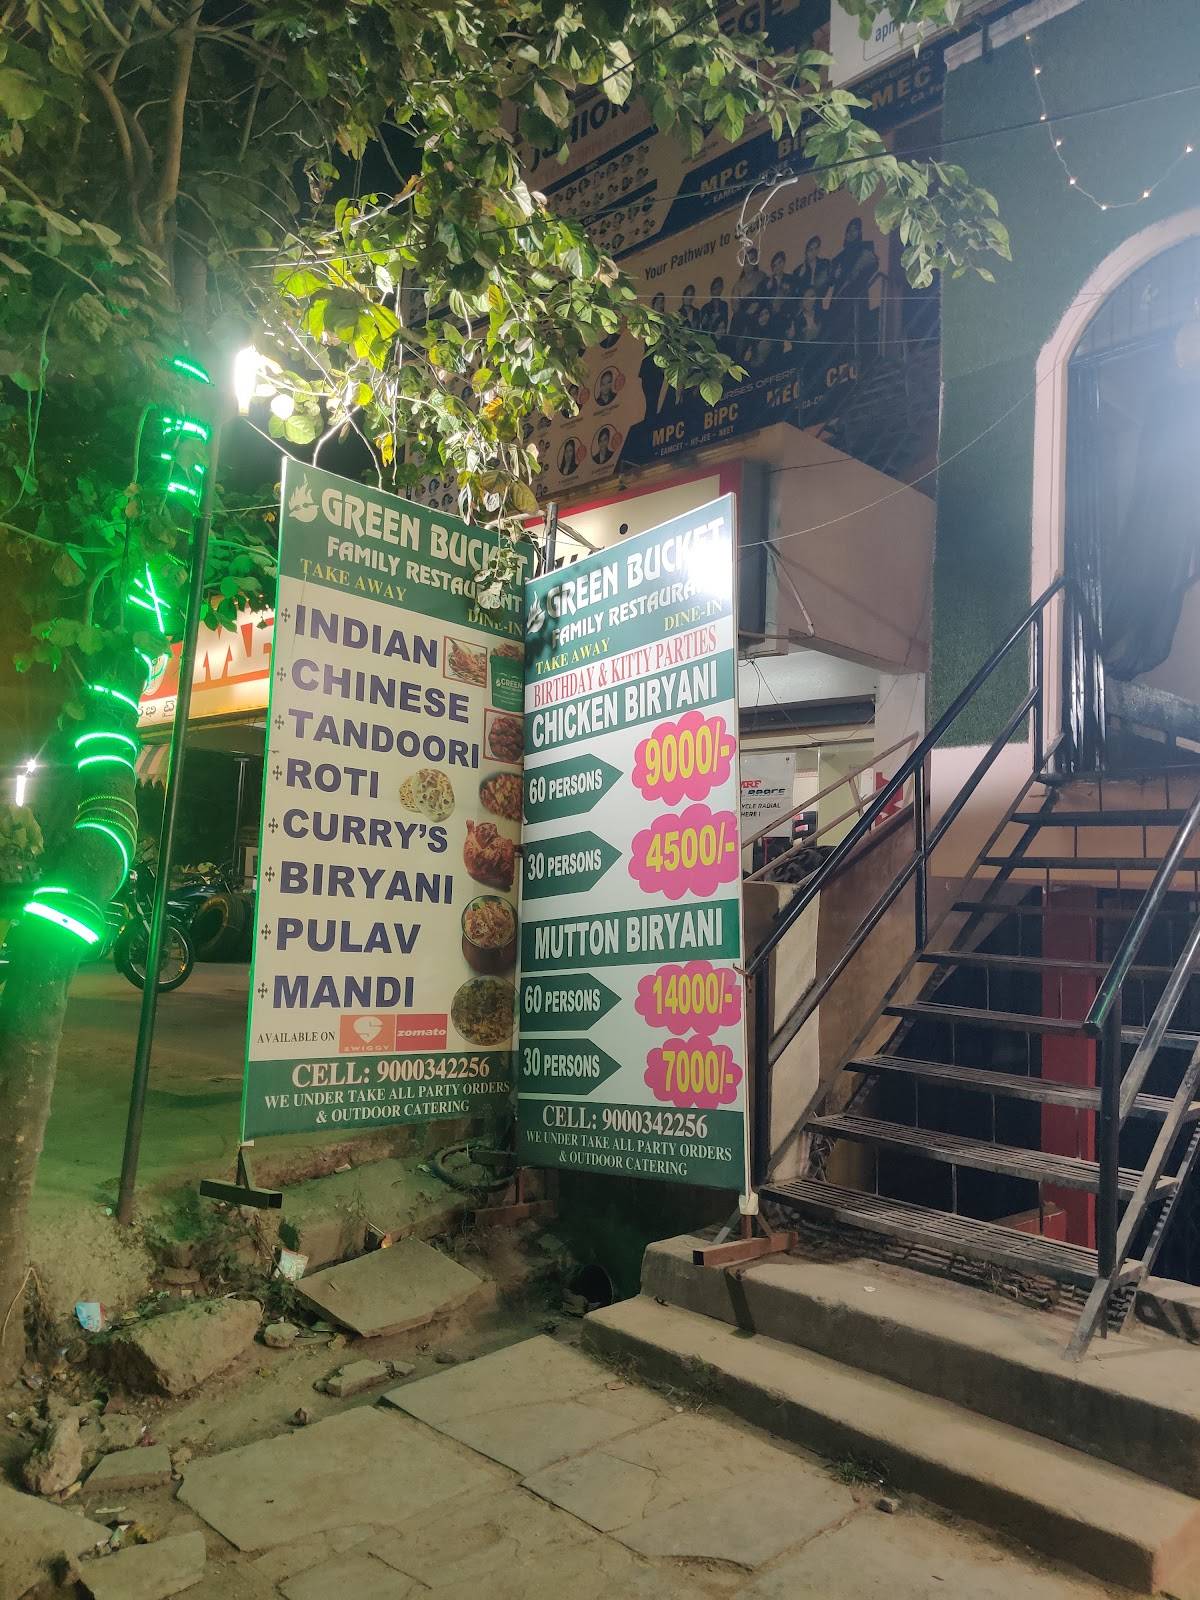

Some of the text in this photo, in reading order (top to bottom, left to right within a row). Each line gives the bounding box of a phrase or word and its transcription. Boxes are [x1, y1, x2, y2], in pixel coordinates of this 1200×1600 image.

[701, 160, 749, 193] MPC
[645, 261, 668, 281] Your
[671, 240, 717, 270] Pathway
[720, 232, 731, 247] to
[652, 421, 685, 448] MPC
[703, 402, 739, 431] BiPC
[321, 488, 421, 552] GREEN
[328, 536, 401, 577] FAMILY
[300, 558, 351, 586] TAKE
[355, 576, 407, 602] AWAY
[546, 562, 618, 619] GREEN
[294, 604, 438, 669] INDIAN
[535, 600, 722, 675] TAKE AWAY DINE-IN
[552, 611, 604, 649] FAMILY
[533, 668, 595, 708] BIRTHDAY
[598, 664, 608, 685] &
[611, 650, 650, 683] KITTY
[655, 624, 717, 671] PARTIES
[291, 658, 470, 724] CHINESE
[532, 660, 717, 748] CHICKEN BIRYANI
[288, 708, 479, 769] TANDOORI
[286, 758, 379, 799] ROTI
[529, 721, 730, 804] 60 PERSONS 9000/-
[527, 822, 735, 881] 30 PERSONS 4500/-
[279, 860, 454, 905] BIRYANI
[276, 917, 421, 954] PULAV
[534, 907, 723, 960] MUTTON BIRYANI
[272, 975, 415, 1009] MANDI
[524, 985, 542, 1014] 60
[545, 989, 600, 1012] PERSONS
[257, 1031, 336, 1044] AVAILABLE ON
[397, 1027, 447, 1038] zomato
[292, 1056, 490, 1088] CELL: 9000342256
[523, 1047, 734, 1095] 30 PERSONS 7000/-
[265, 1081, 510, 1109] WE UNDER TAKE ALL PARTY ORDERS
[315, 1100, 470, 1124] & OUTDOOR CATERING
[542, 1105, 708, 1139] CELL: 9000342256
[526, 1130, 732, 1161] WE UNDER TAKE ALL PARTY ORDERS
[558, 1150, 688, 1176] & OUTDOOR CATERING
